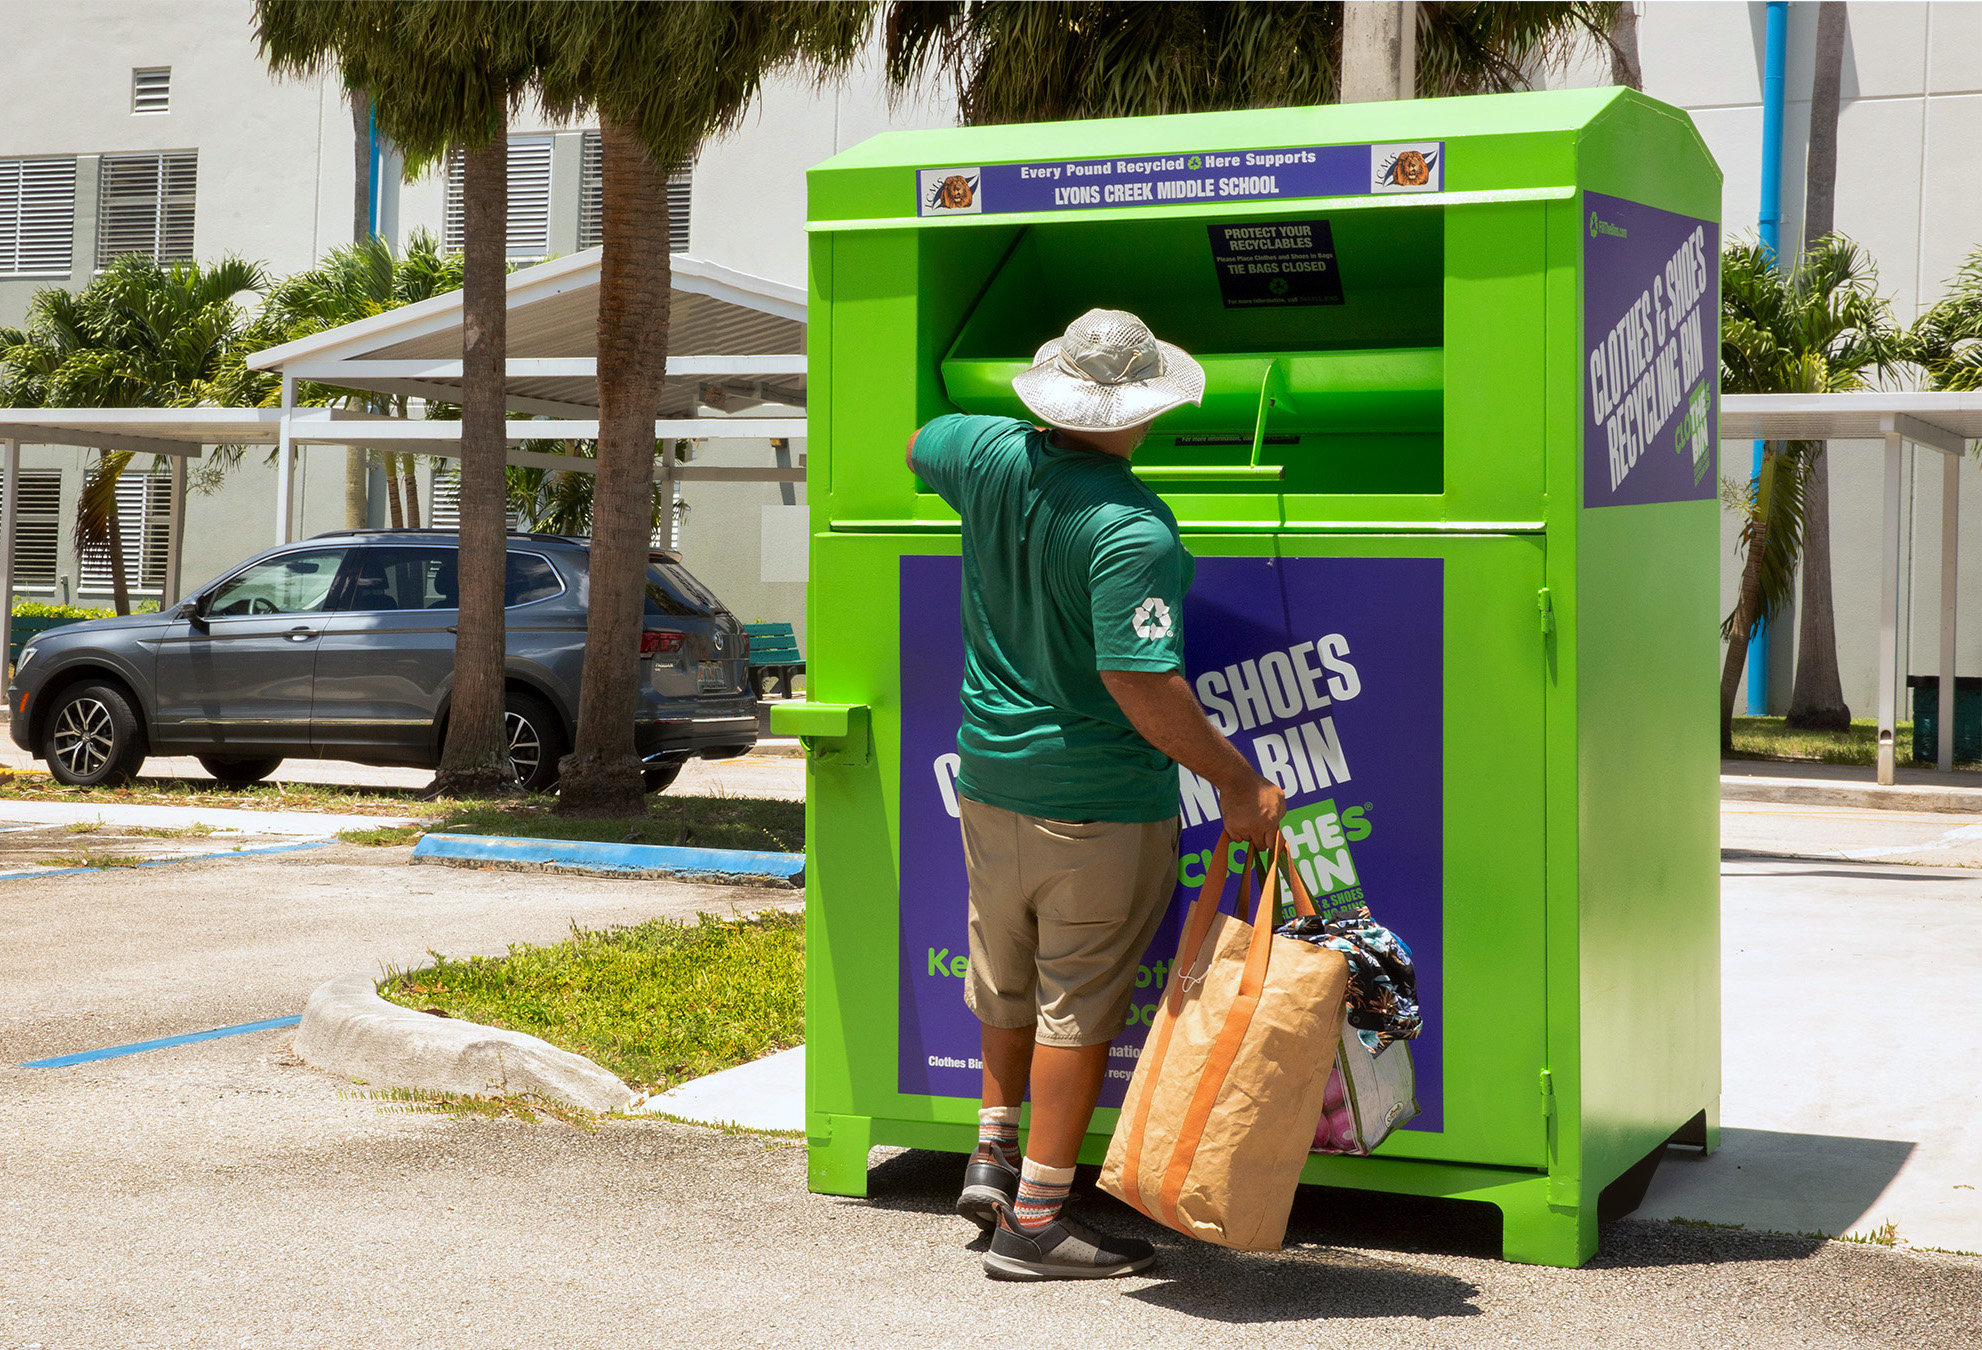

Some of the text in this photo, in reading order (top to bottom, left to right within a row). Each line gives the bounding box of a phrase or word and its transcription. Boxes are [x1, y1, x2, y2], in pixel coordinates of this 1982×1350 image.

[1021, 151, 1317, 180] Every Pound Recycled Here Supports
[1055, 175, 1279, 205] LYONS CREEK MIDDLE SCHOOL
[1224, 225, 1312, 239] PROTECT YOUR
[1229, 237, 1313, 251] RECYCLABLES
[1227, 261, 1327, 274] TIE BAGS CLOSED
[1290, 252, 1310, 260] Shoes
[1317, 252, 1333, 260] Bags
[1590, 224, 1707, 426] CLOTHES & SHOES
[1606, 304, 1704, 493] RECYCLING BIN
[1674, 382, 1711, 455] CLOTHES
[1691, 417, 1708, 465] BIN
[1195, 633, 1361, 738] SHOES
[1252, 716, 1351, 800] BIN
[1330, 887, 1364, 906] SHOES
[928, 1055, 966, 1069] Clothes
